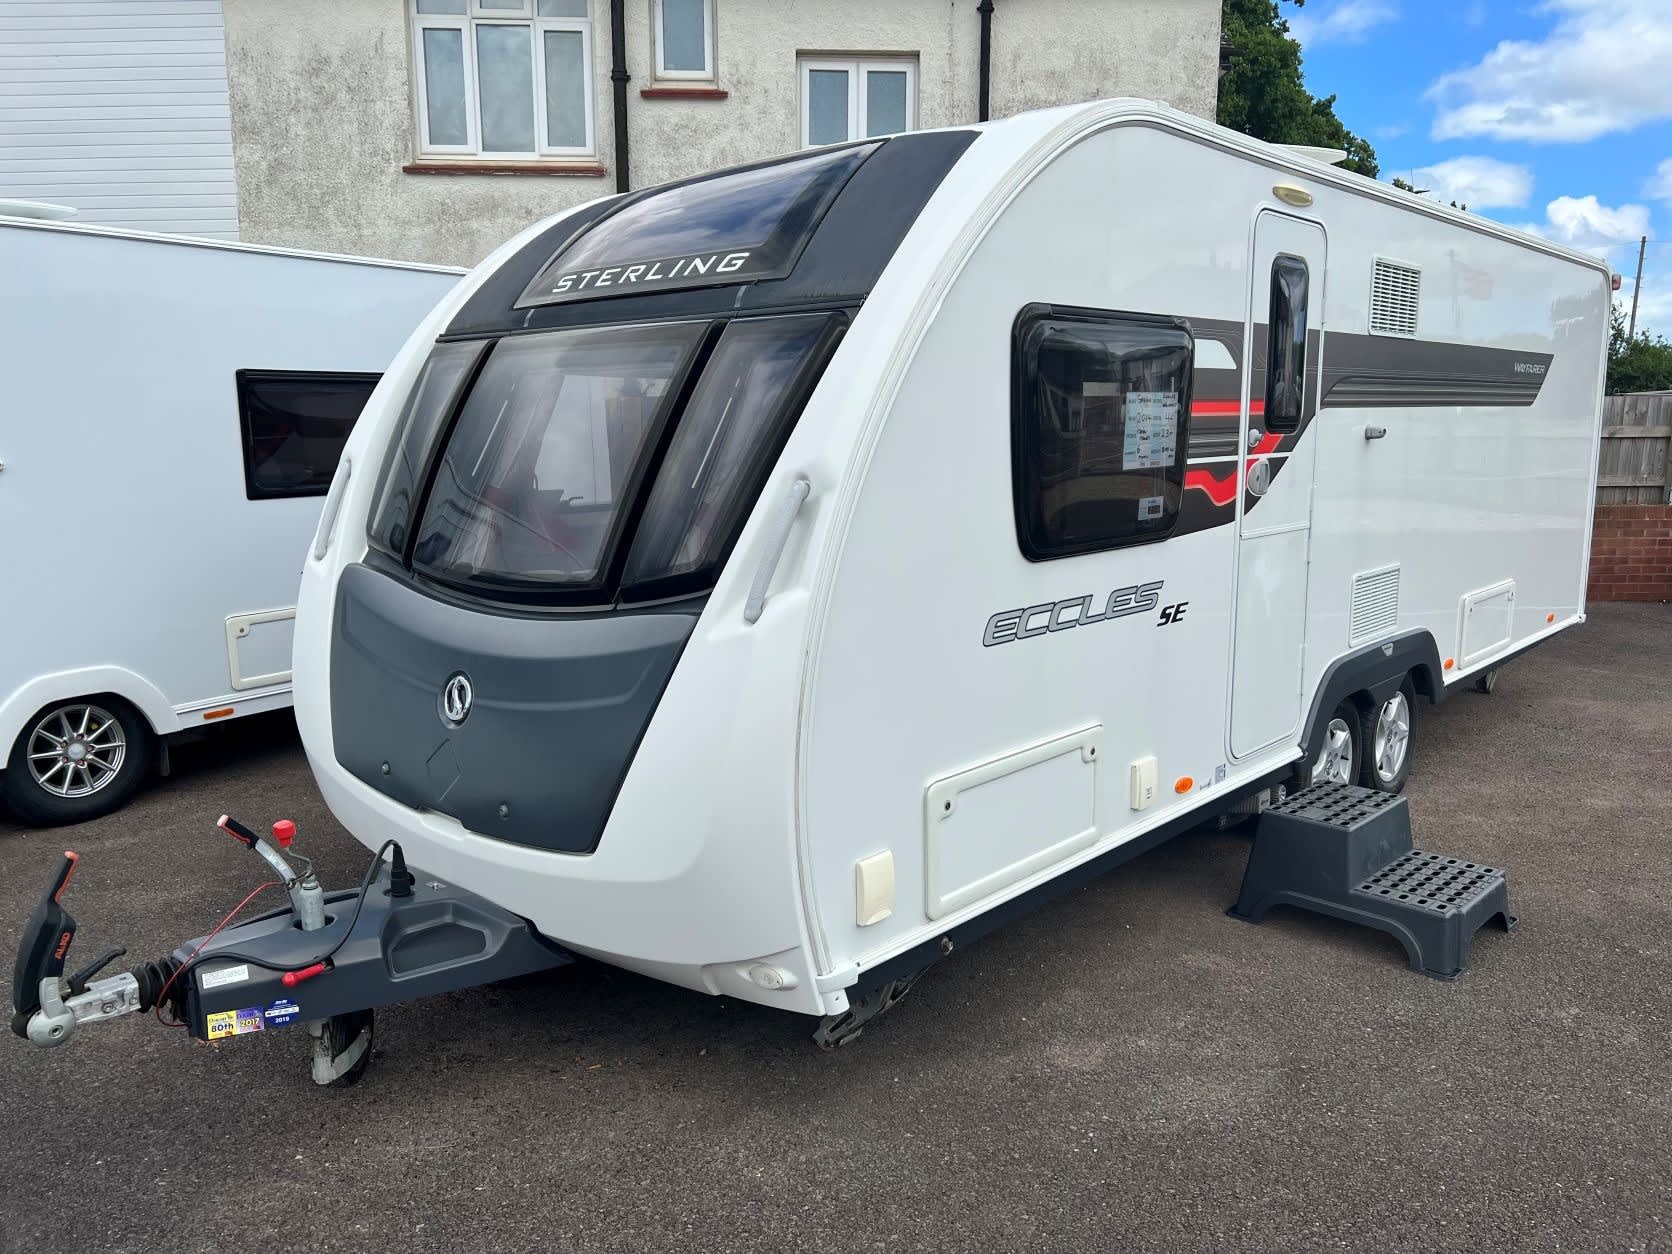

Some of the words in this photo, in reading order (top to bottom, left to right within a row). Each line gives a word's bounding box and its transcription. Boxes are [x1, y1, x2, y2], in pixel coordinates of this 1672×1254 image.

[552, 252, 750, 293] STERLING
[1513, 361, 1546, 374] WAYFARER
[983, 580, 1165, 647] ECCLES
[1157, 602, 1189, 627] SE
[241, 1018, 260, 1027] 2017
